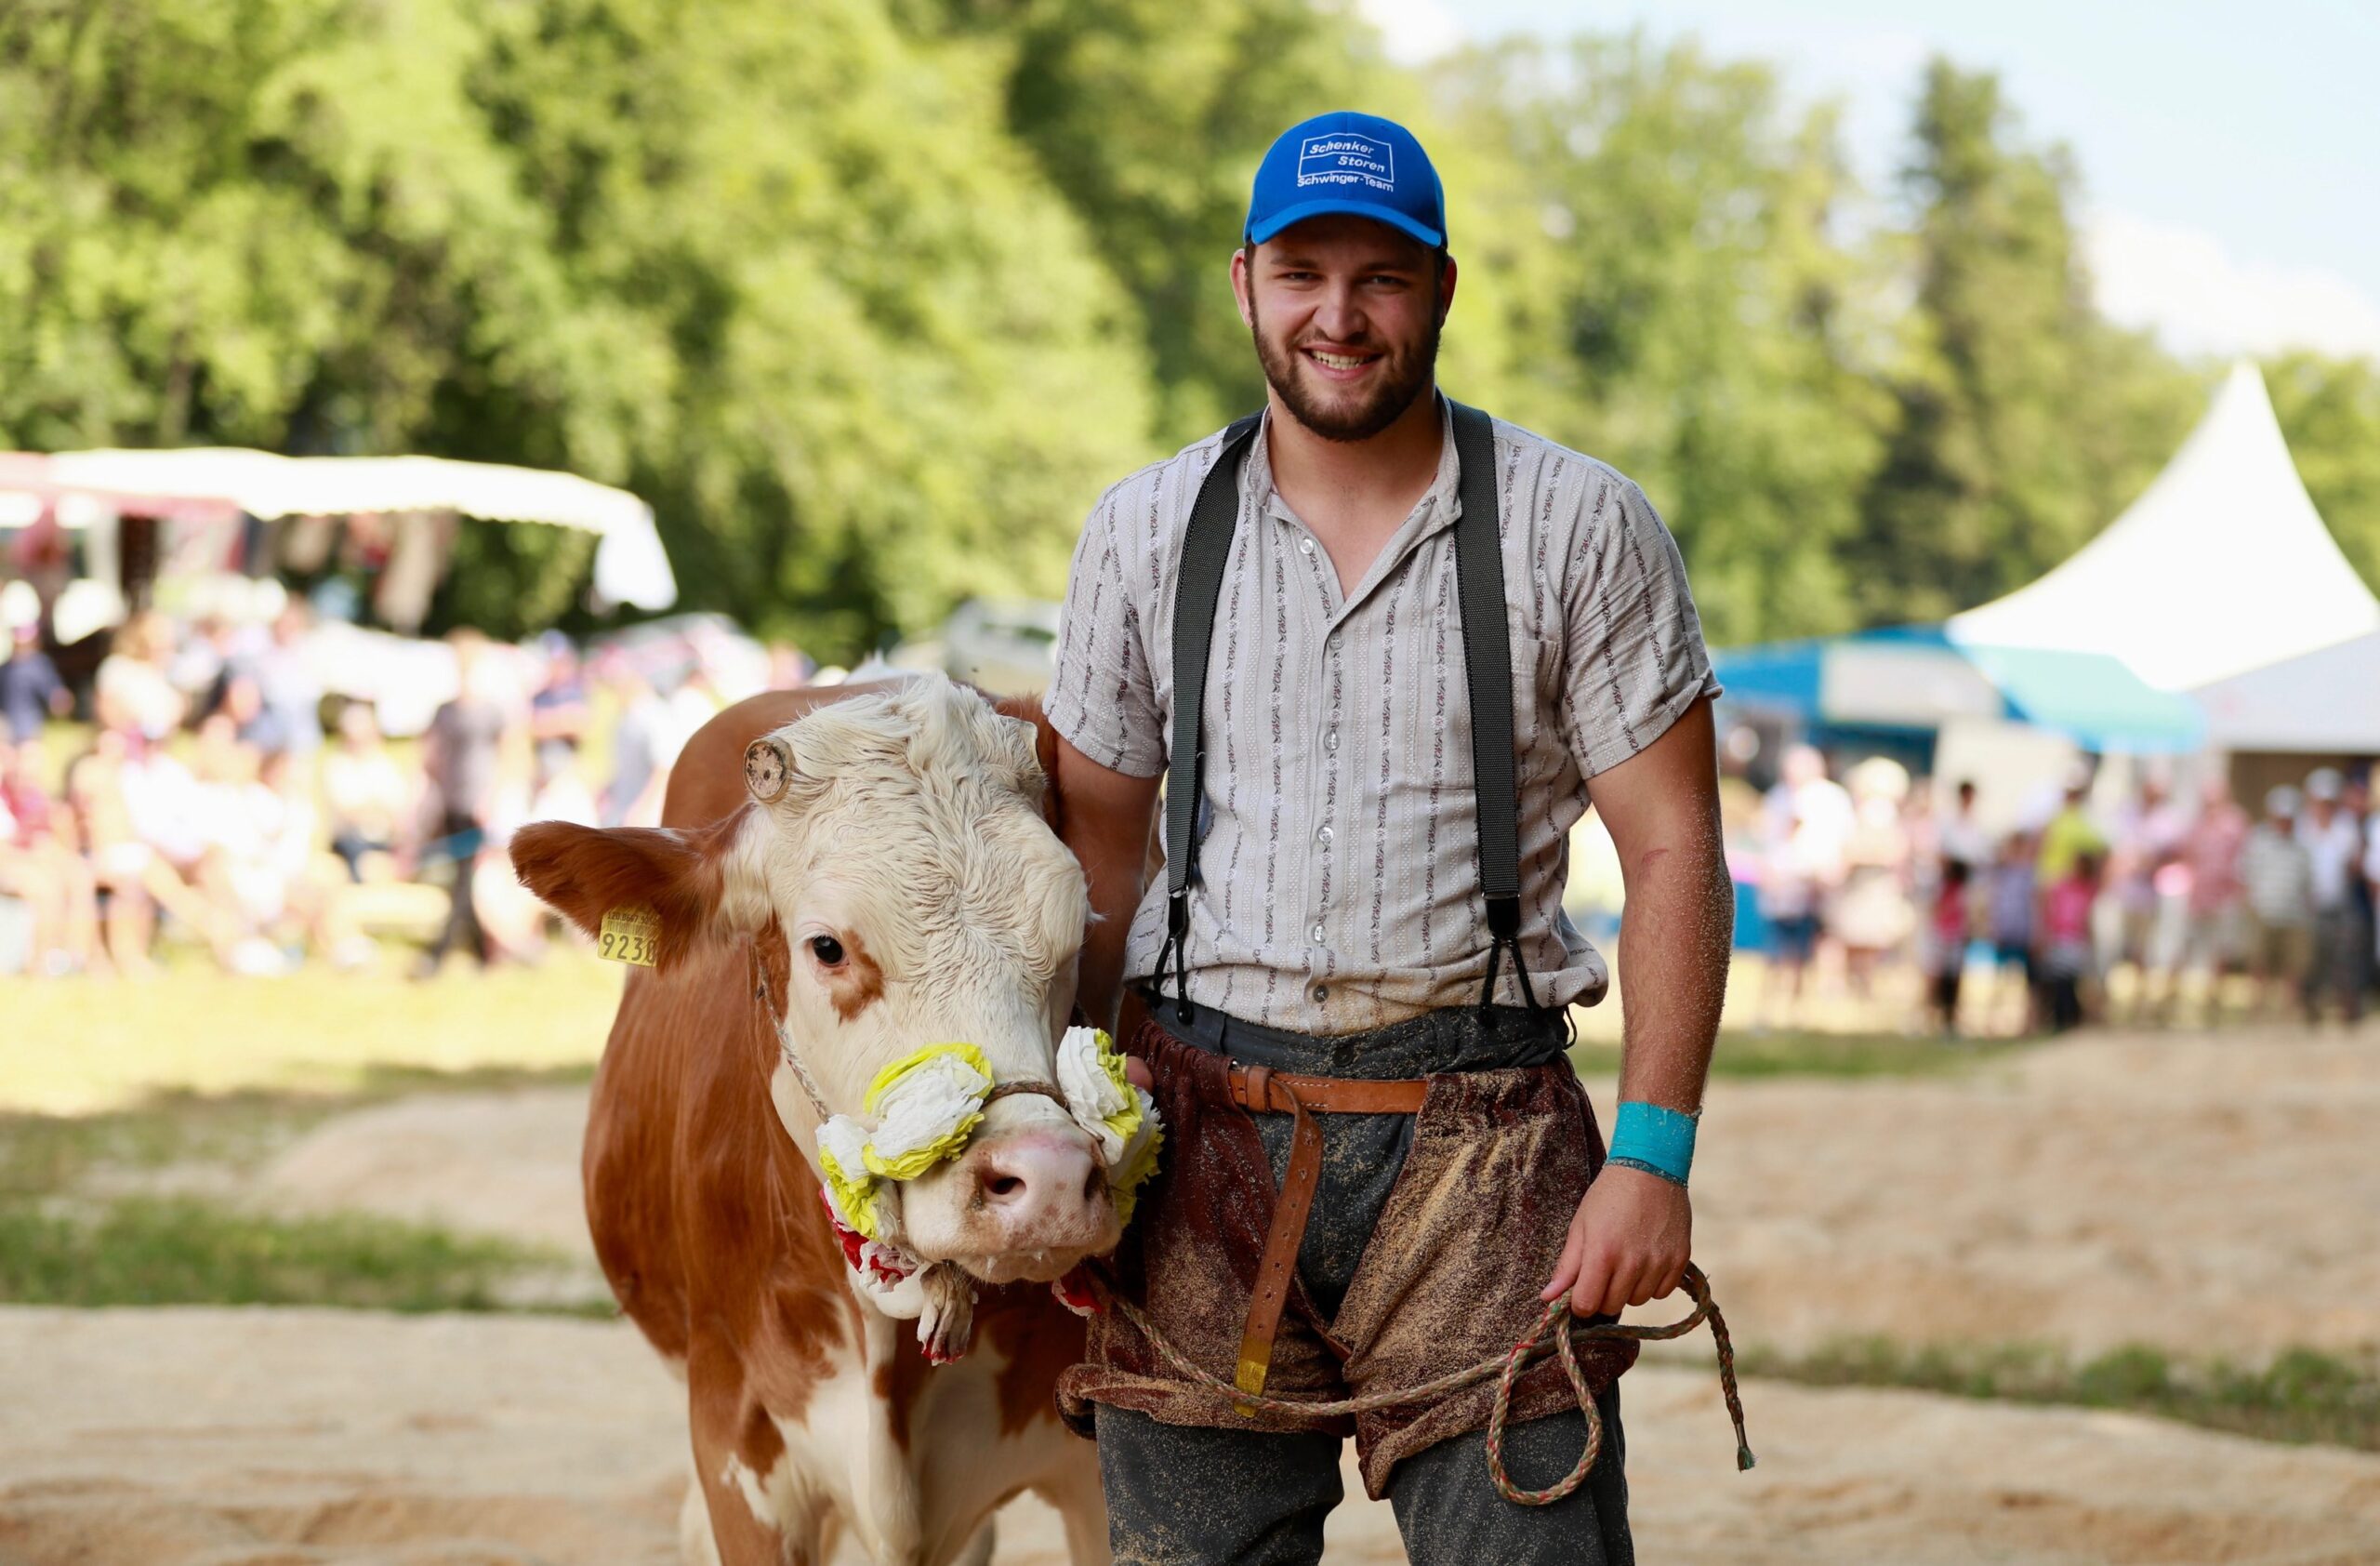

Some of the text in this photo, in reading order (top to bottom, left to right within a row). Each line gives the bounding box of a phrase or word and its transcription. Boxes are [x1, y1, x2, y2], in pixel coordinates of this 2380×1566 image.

[1309, 140, 1374, 154] Schenker
[1338, 155, 1385, 173] Storen
[1297, 173, 1394, 192] Schwinger-Team
